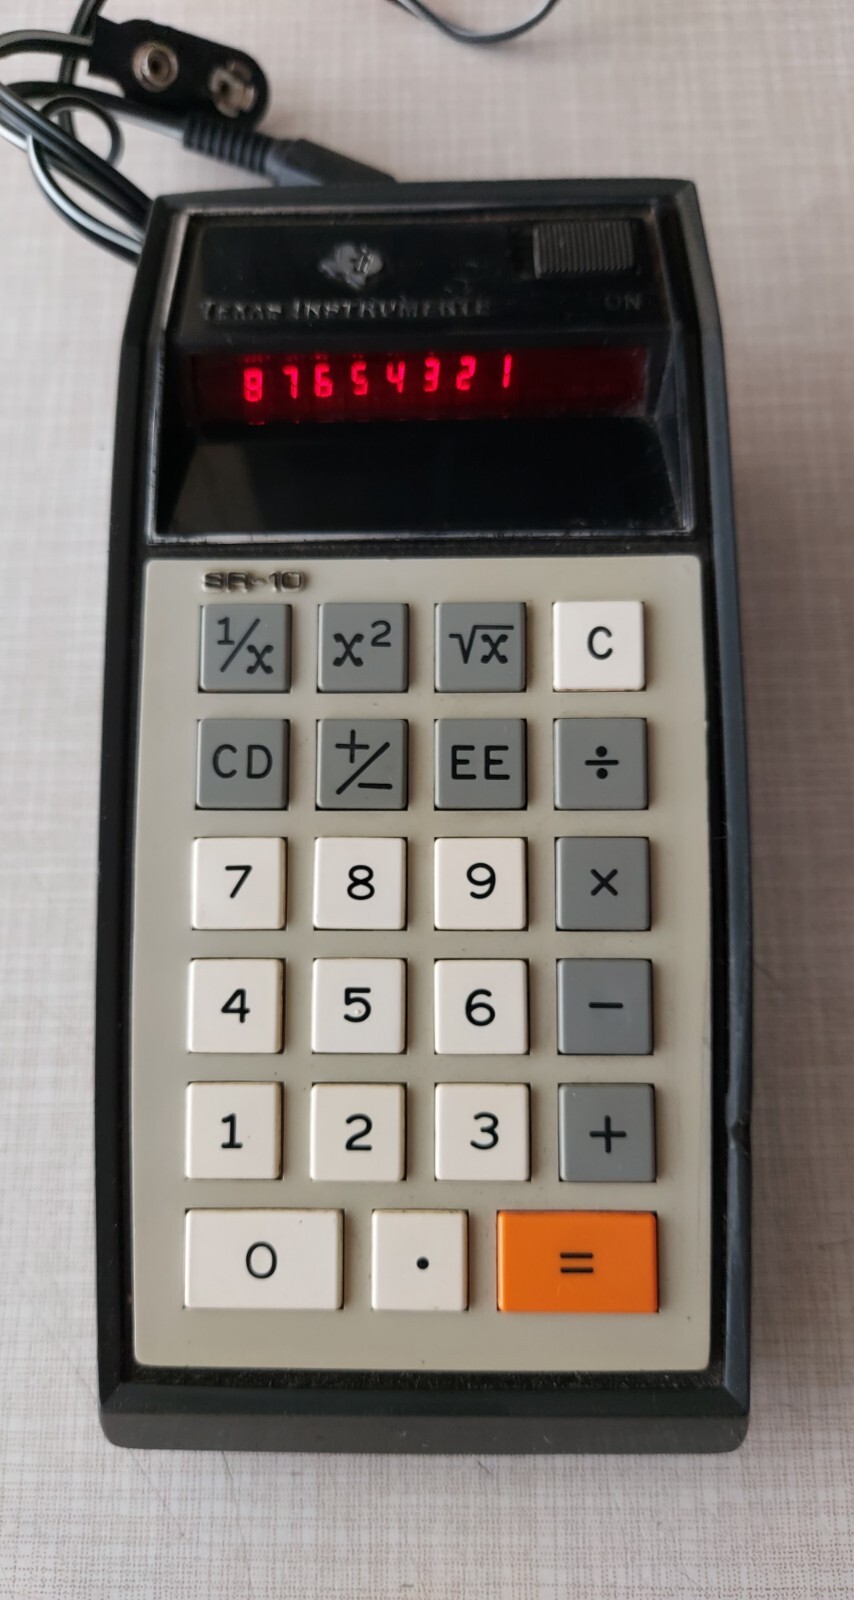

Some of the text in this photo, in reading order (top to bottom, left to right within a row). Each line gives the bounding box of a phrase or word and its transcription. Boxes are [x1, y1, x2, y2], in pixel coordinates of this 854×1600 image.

[604, 292, 641, 311] ON
[202, 571, 308, 592] SR-10
[587, 626, 613, 660] C
[212, 744, 272, 778] CD
[451, 744, 510, 780] EE
[224, 864, 253, 898] 7
[346, 864, 375, 900] 8
[466, 862, 496, 899] 9
[221, 987, 250, 1023] 4
[343, 987, 372, 1023] 5
[464, 989, 496, 1026] 6
[220, 1113, 243, 1149] 1
[345, 1113, 373, 1151] 2
[469, 1111, 499, 1150] 3
[245, 1241, 277, 1278] 0
